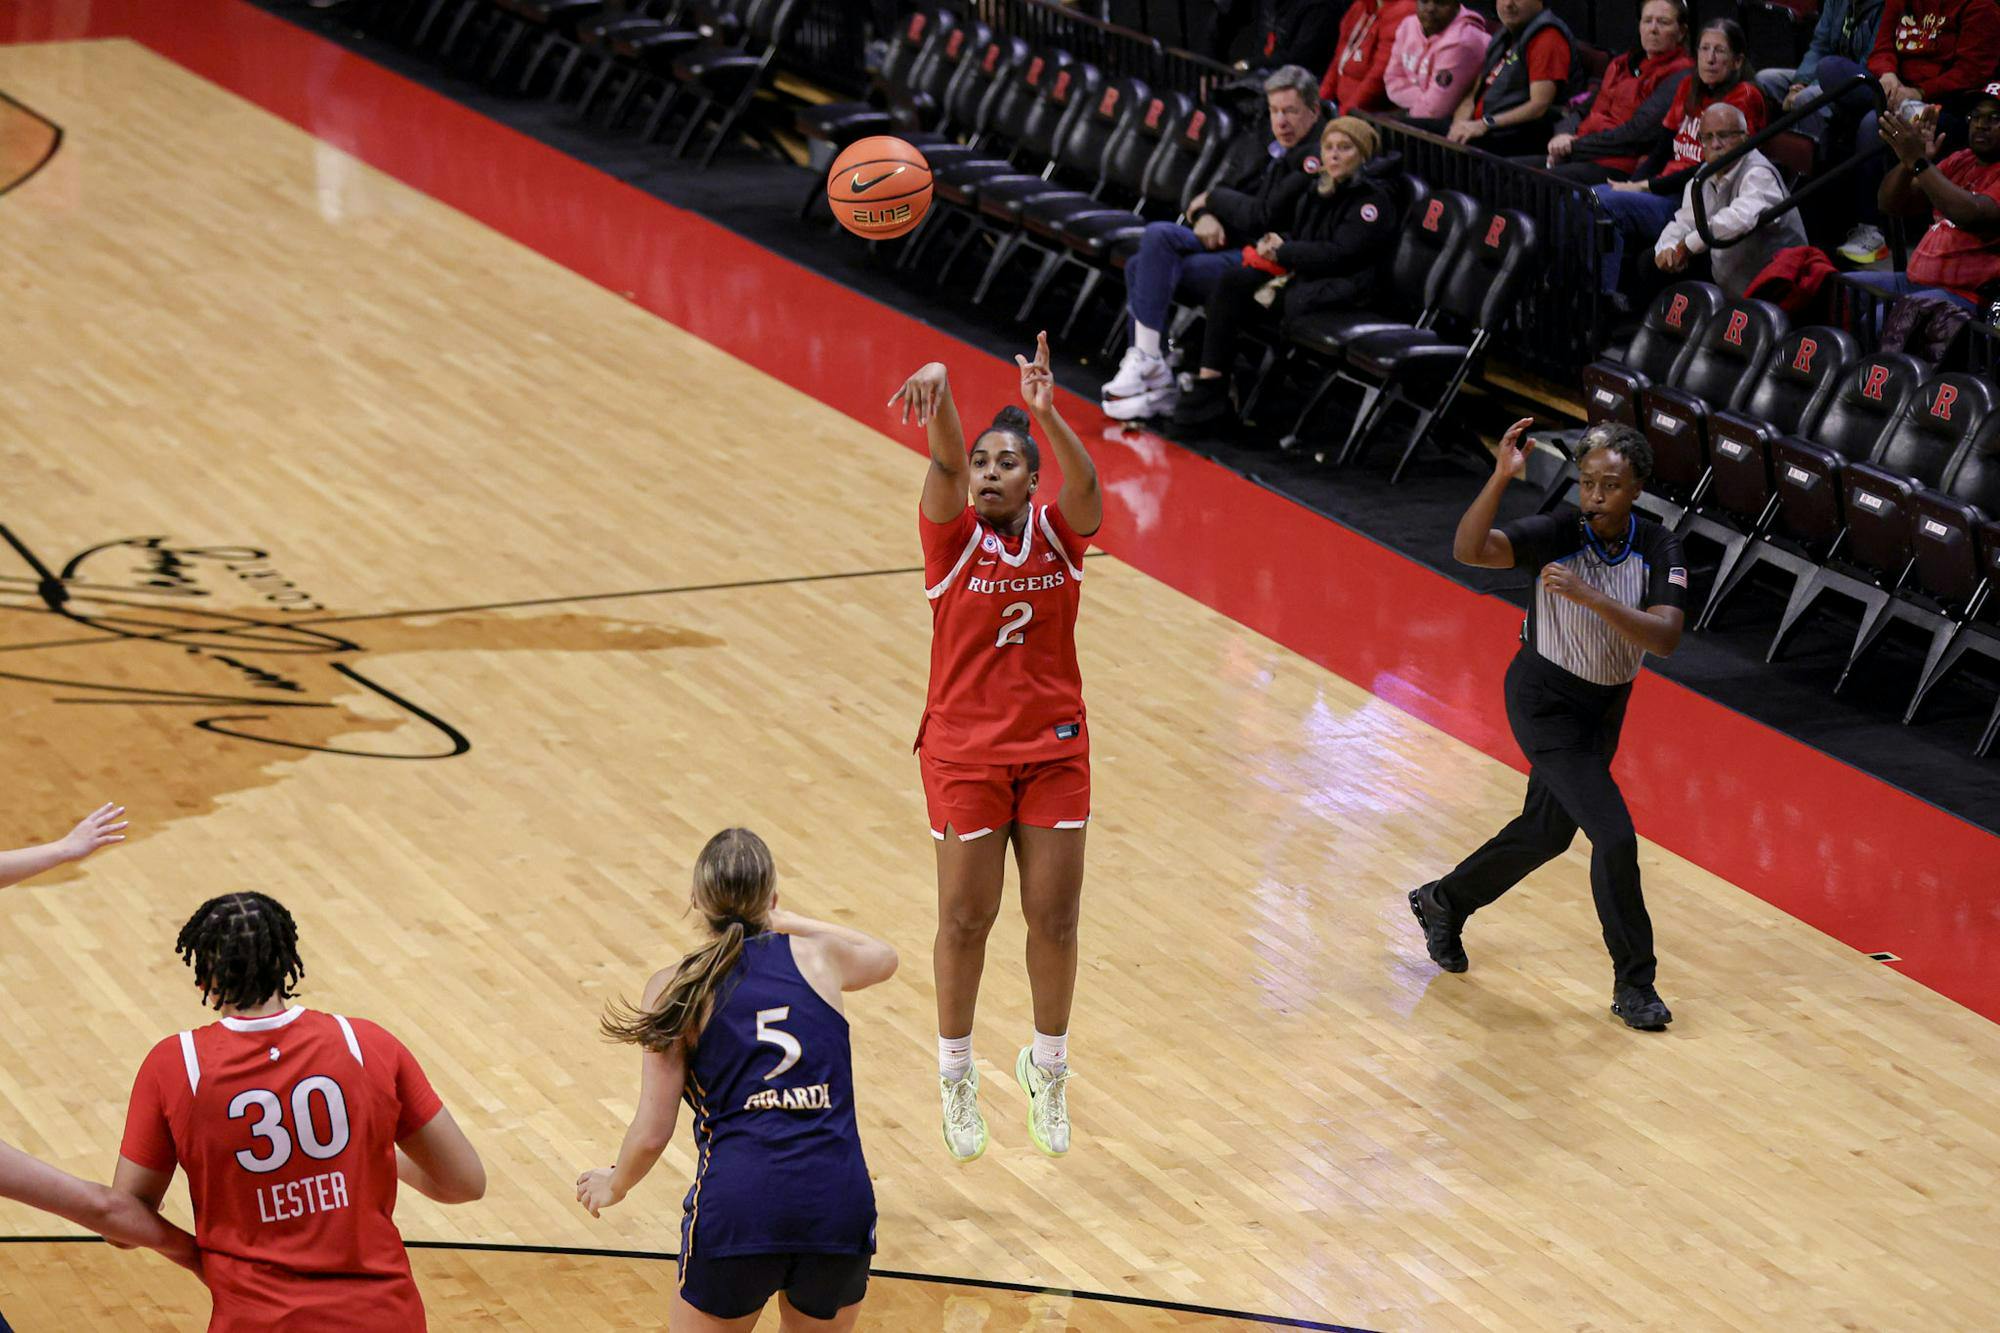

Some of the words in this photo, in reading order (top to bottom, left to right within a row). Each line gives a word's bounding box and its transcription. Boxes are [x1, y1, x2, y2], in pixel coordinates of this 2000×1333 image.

[1421, 198, 1445, 232] R
[1484, 214, 1507, 249] R
[1665, 293, 1690, 327] R
[1723, 309, 1749, 346] R
[1791, 337, 1818, 374] R
[1862, 364, 1890, 401] R
[1929, 383, 1959, 421] R
[967, 571, 1066, 595] RUTGERS
[995, 601, 1034, 649] 2
[755, 1005, 803, 1081] 5
[743, 1083, 833, 1110] GIRARDI
[228, 1075, 351, 1173] 30
[257, 1171, 349, 1223] LESTER
